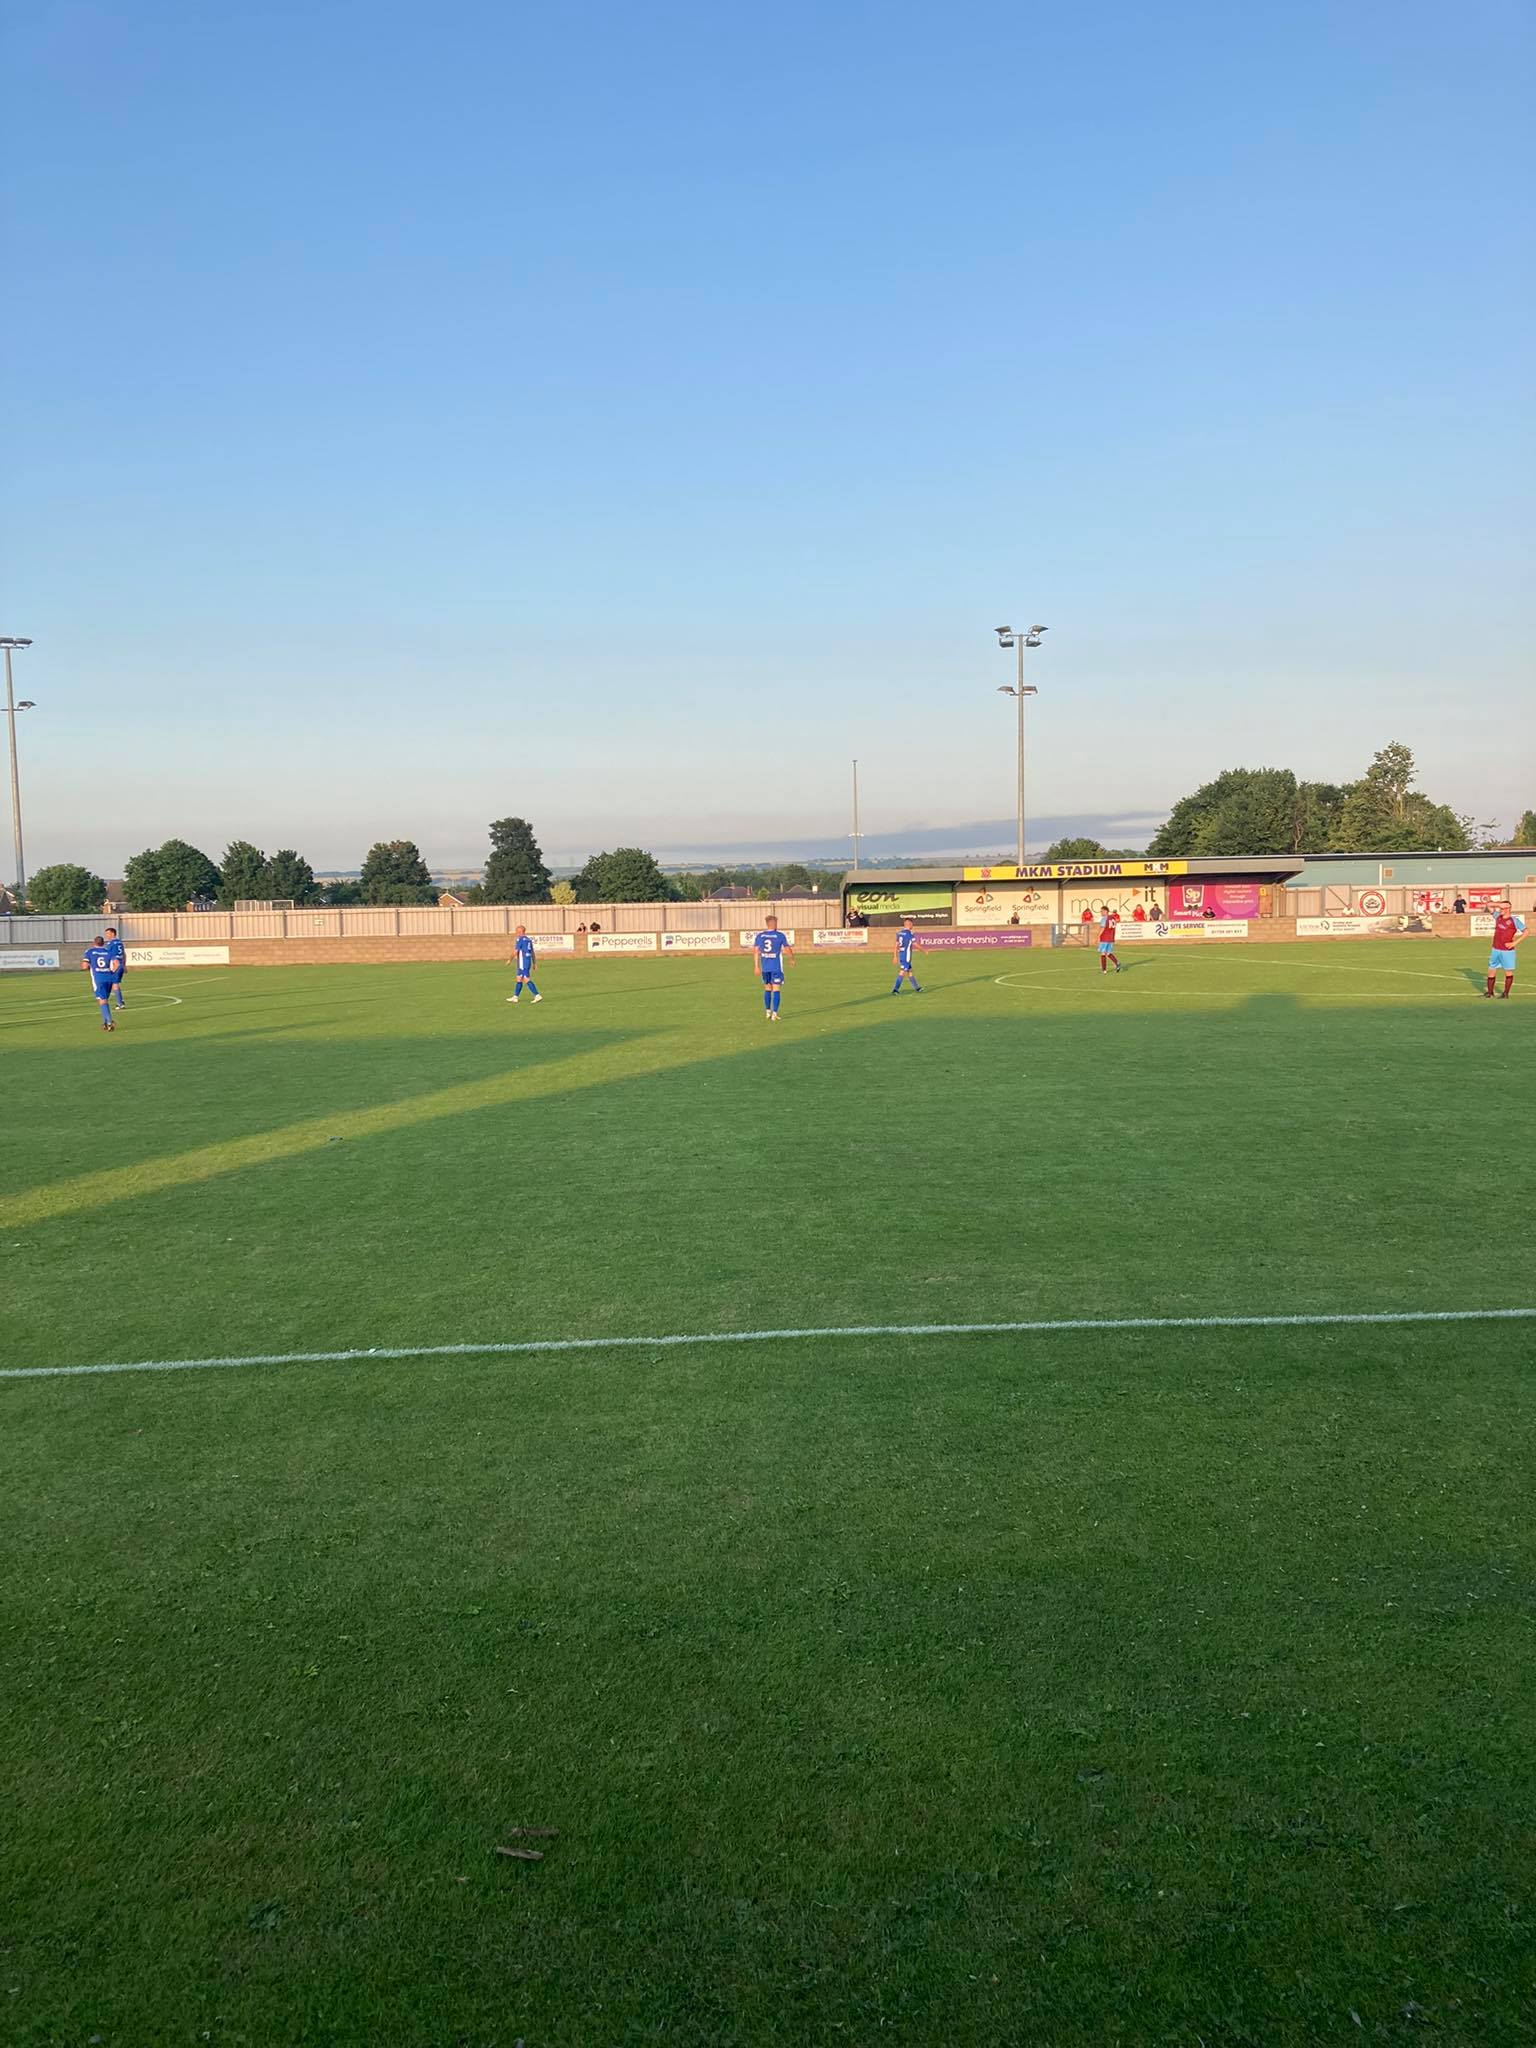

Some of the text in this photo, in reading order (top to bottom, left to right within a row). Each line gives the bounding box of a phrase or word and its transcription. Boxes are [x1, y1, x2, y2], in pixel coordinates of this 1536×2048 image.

[1015, 864, 1122, 877] MKM STADIUM
[857, 890, 900, 903] eon
[1145, 886, 1156, 902] it
[1071, 893, 1130, 913] mock
[602, 936, 652, 948] Pepperells
[675, 934, 726, 946] Pepperells
[764, 939, 772, 952] 3
[920, 936, 956, 945] Insurance
[957, 935, 998, 945] Partnership
[117, 945, 122, 955] 5
[131, 951, 153, 961] RNS
[97, 957, 106, 967] 6
